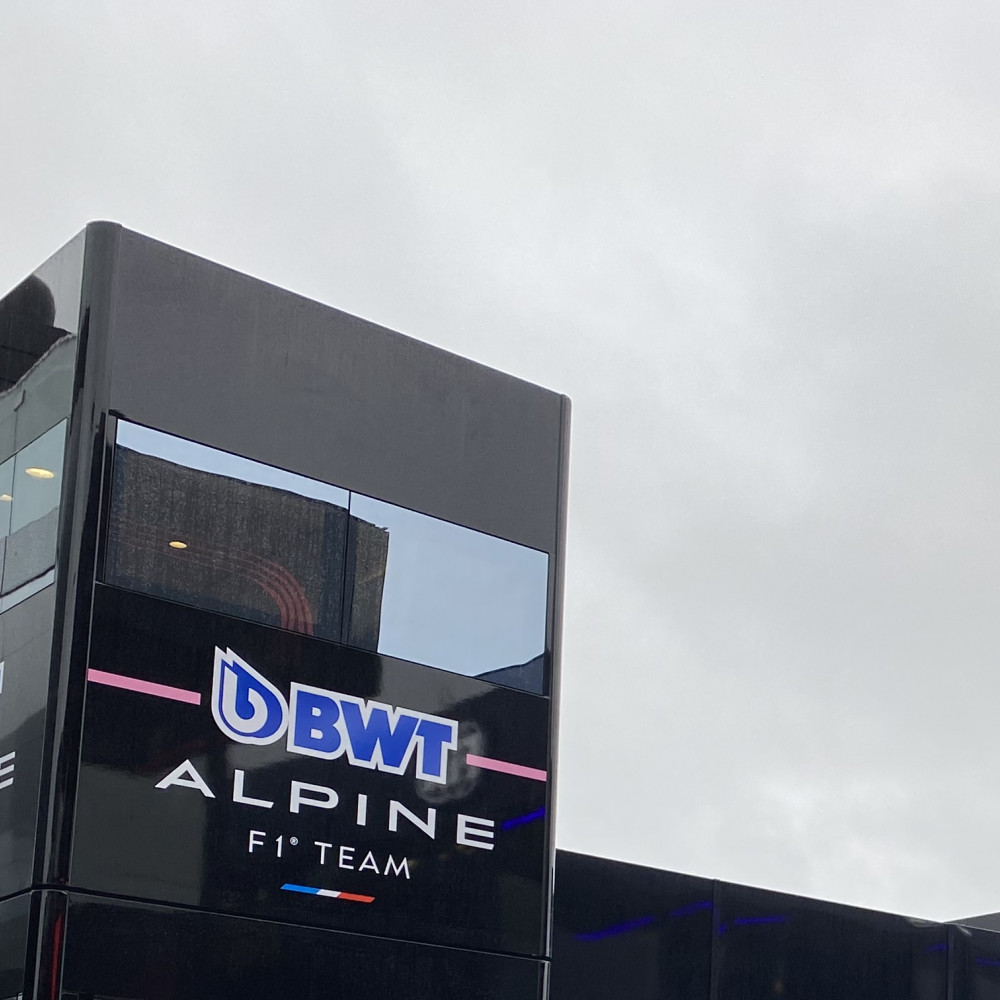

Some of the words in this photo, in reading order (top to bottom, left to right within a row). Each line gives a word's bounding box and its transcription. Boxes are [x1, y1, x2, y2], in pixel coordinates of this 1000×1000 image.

[286, 681, 459, 785] BWT
[155, 759, 496, 850] ALPINE
[314, 842, 411, 880] TEAM
